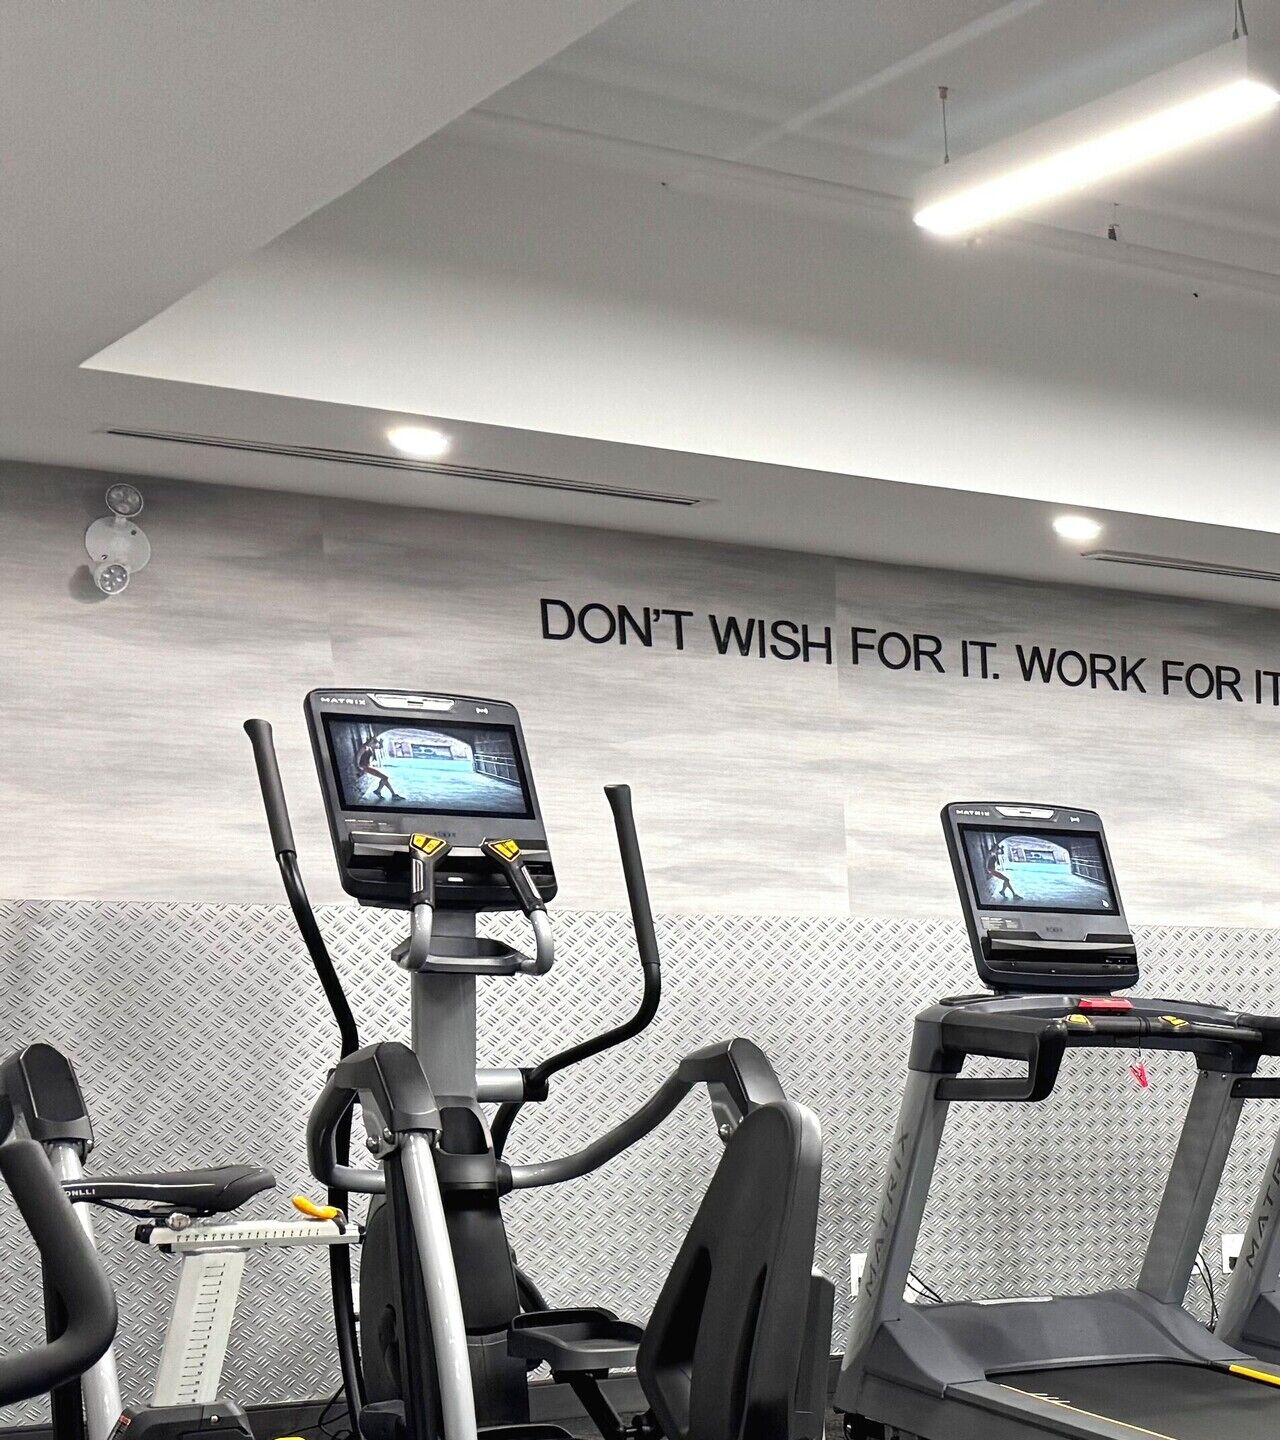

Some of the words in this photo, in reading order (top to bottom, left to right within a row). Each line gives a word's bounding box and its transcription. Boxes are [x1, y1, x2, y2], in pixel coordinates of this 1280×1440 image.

[540, 598, 694, 651] DON'T
[708, 614, 833, 665] WISH
[851, 626, 946, 673] FOR
[960, 640, 1000, 680] IT.
[1015, 644, 1148, 694] WORK
[1162, 659, 1243, 702] FOR
[320, 696, 366, 706] MATRIX
